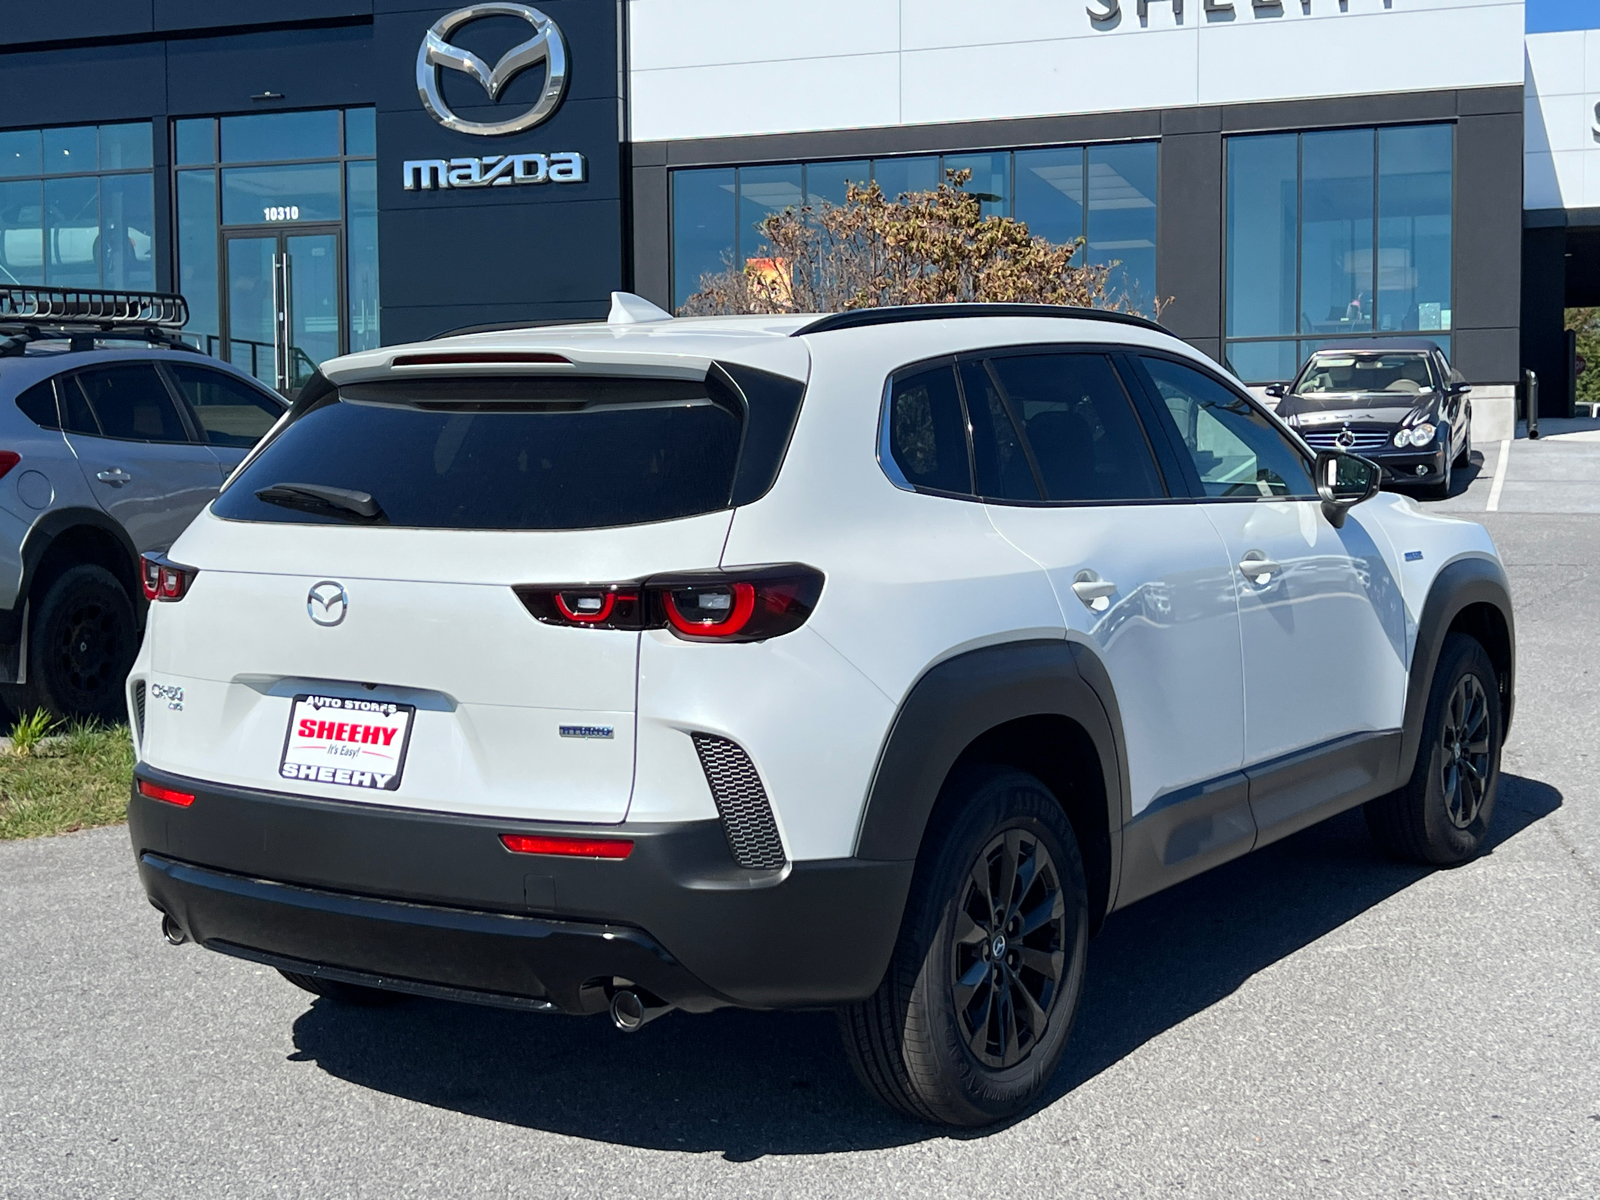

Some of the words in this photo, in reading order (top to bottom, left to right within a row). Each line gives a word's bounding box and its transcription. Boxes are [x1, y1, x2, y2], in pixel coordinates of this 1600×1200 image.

[403, 152, 587, 190] mazda
[263, 206, 299, 221] 10310
[305, 695, 342, 708] AUTO
[298, 718, 399, 746] SHEEHY
[327, 743, 339, 755] It's
[340, 745, 361, 760] Easy!
[282, 762, 396, 789] SHEEHY
